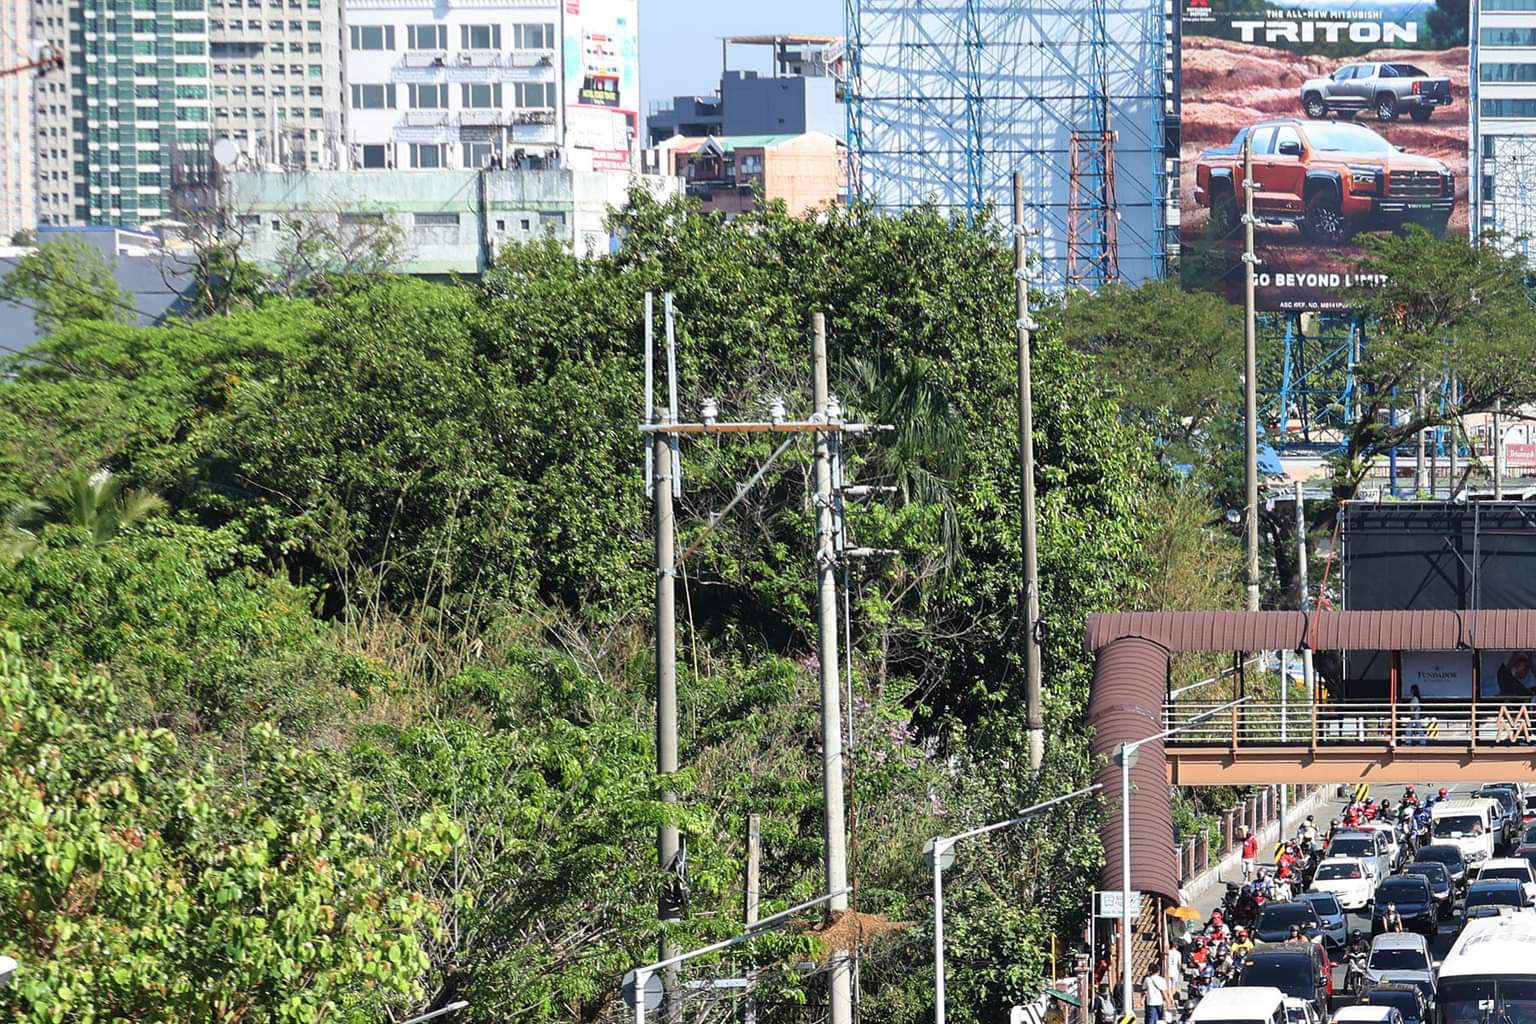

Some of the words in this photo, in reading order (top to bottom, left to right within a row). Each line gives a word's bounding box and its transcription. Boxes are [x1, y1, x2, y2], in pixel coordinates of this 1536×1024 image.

[1266, 10, 1283, 19] THE
[1330, 10, 1383, 19] MITSUBISHI
[1231, 21, 1418, 43] TRITON
[1275, 273, 1341, 287] BEYOND
[1418, 671, 1457, 679] FUNDADOR
